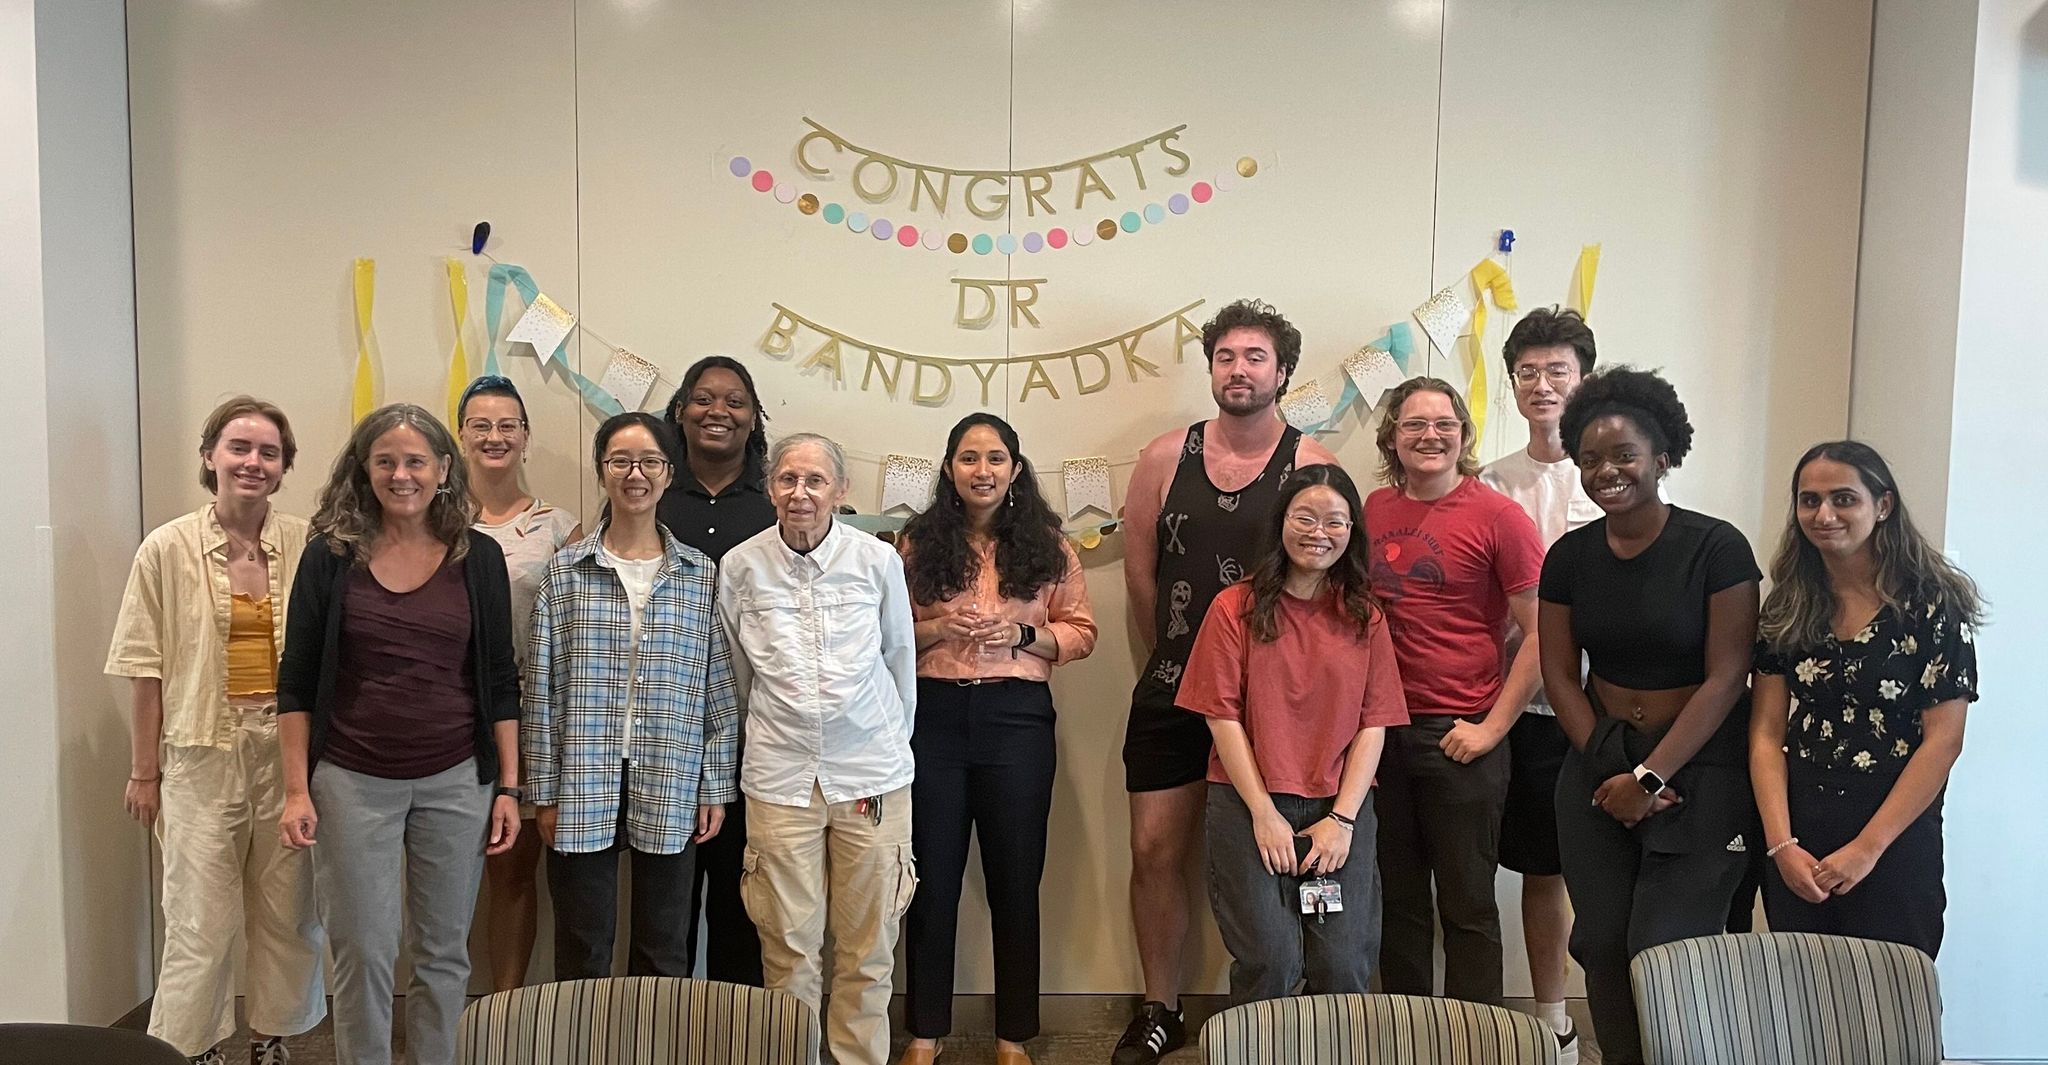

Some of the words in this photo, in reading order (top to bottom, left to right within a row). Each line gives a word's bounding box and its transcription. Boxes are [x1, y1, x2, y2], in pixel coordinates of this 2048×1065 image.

[797, 130, 1190, 219] CONGRATS
[957, 281, 1041, 328] DR
[760, 309, 1204, 406] BANDYADKA
